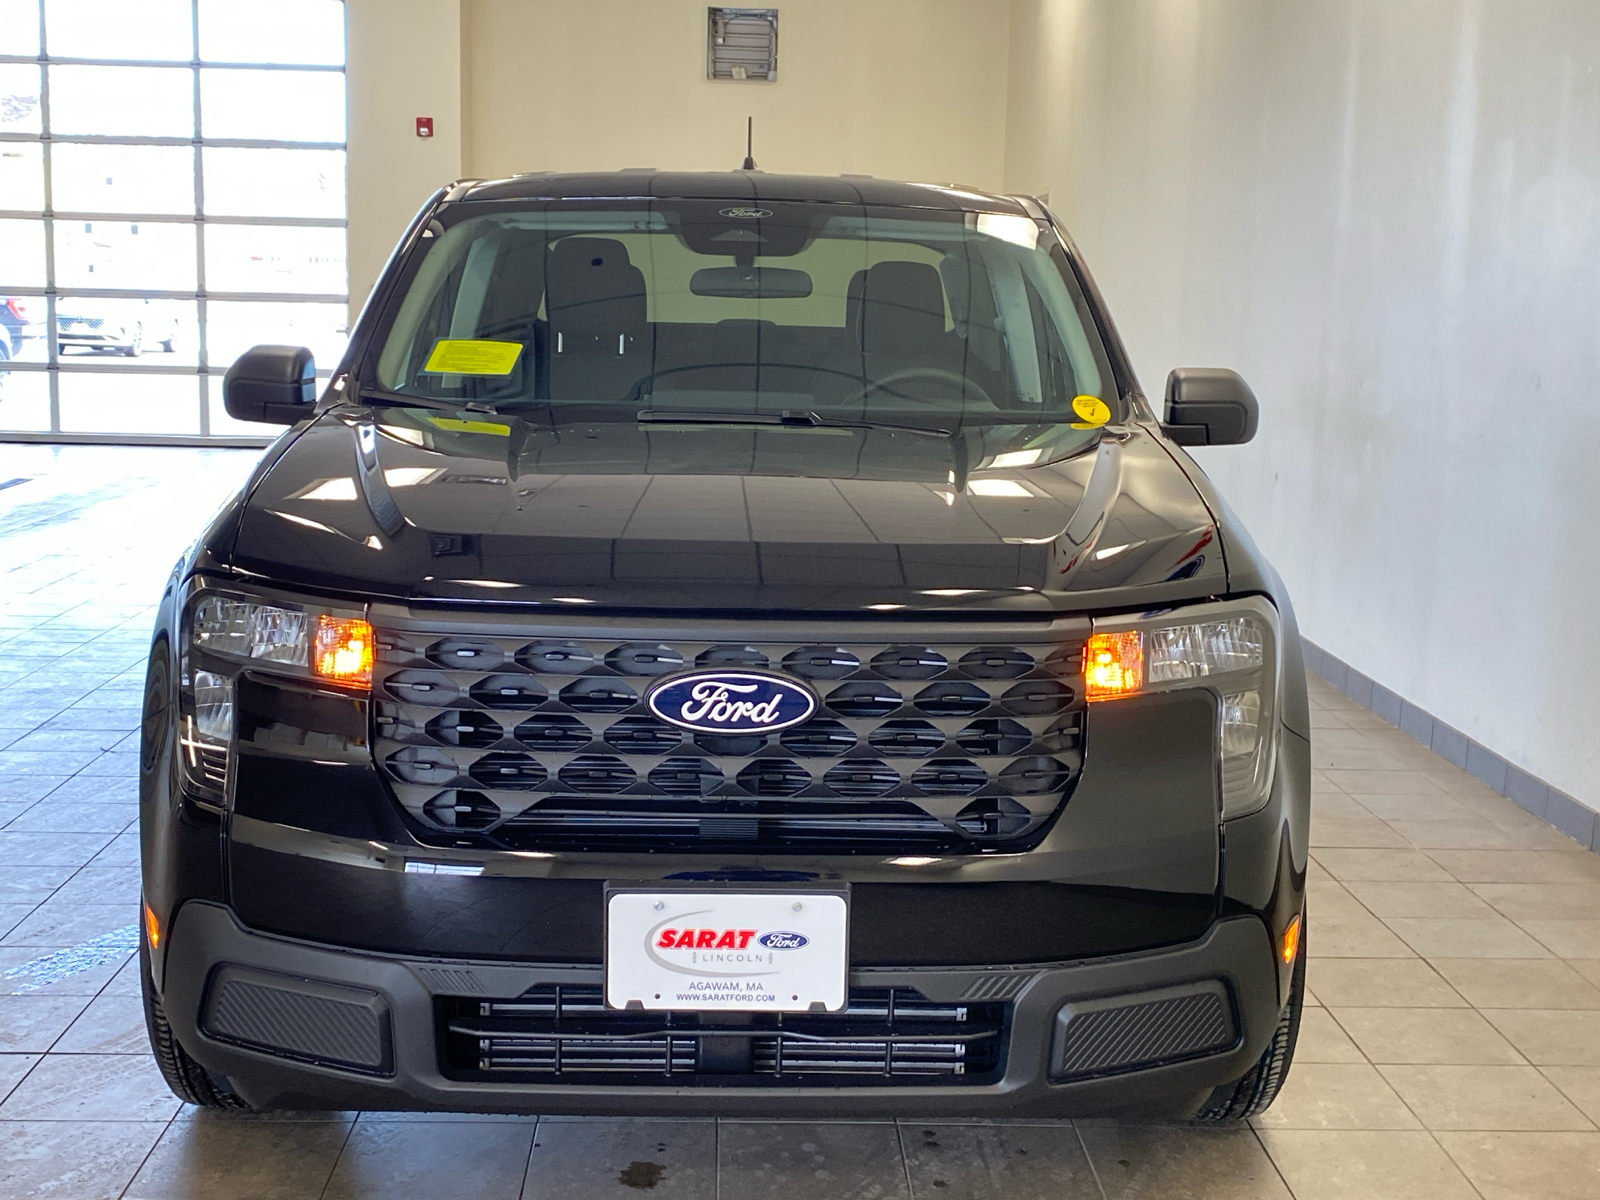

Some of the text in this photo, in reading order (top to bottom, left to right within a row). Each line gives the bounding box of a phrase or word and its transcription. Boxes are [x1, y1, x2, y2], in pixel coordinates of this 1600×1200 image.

[728, 208, 763, 217] Ford
[680, 681, 783, 723] Ford
[656, 928, 801, 950] SARAT Ford
[702, 954, 763, 962] LINCOLN
[688, 981, 764, 992] AGAWAM, MA
[676, 993, 776, 1002] WWW.SARATFORD.COM
